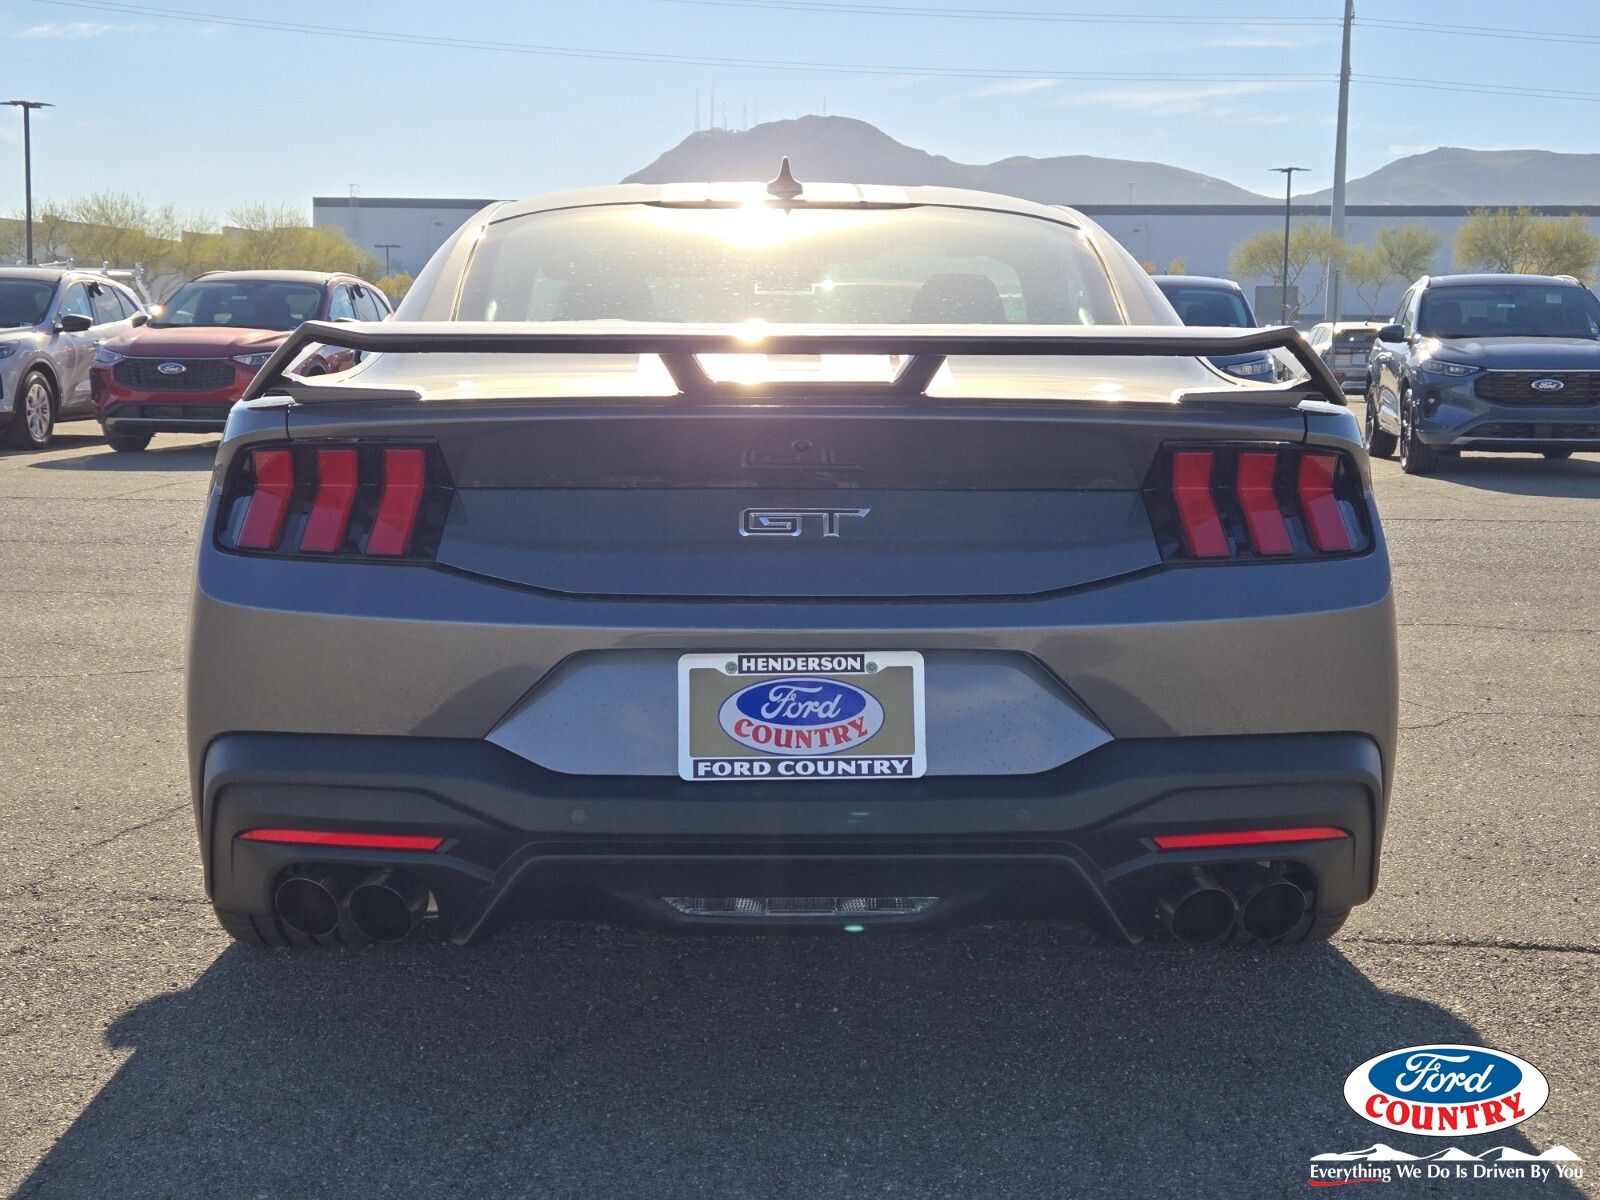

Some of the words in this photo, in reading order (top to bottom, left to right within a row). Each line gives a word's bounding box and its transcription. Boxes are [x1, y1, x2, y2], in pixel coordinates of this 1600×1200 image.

[739, 508, 870, 537] GT
[741, 656, 862, 672] HENDERSON
[761, 685, 842, 719] Ford
[734, 716, 868, 749] COUNTRY
[698, 760, 771, 776] FORD
[777, 759, 909, 775] COUNTRY
